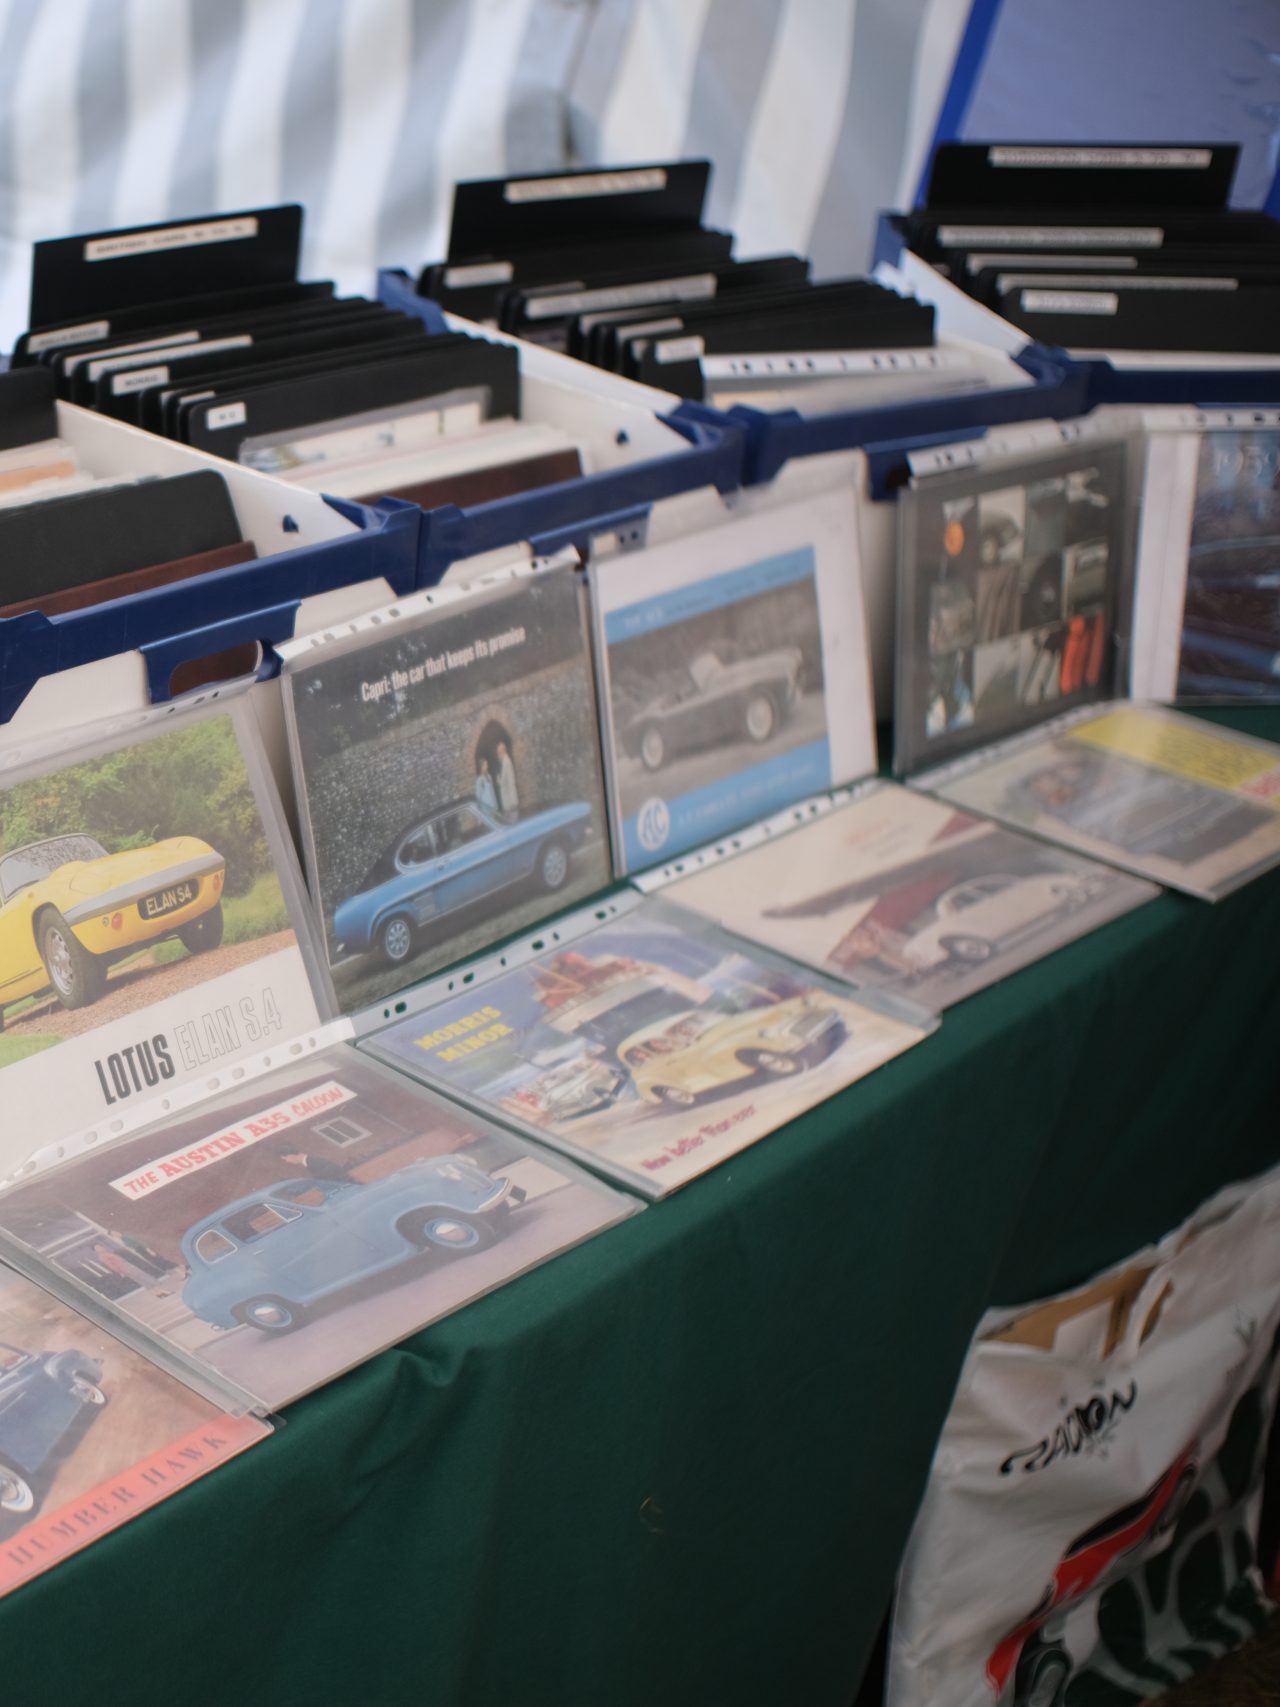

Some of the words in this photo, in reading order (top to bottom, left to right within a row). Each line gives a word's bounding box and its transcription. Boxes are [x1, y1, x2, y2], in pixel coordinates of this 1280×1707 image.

[361, 675, 392, 701] Capri:
[392, 668, 409, 690] the
[409, 667, 425, 684] car
[425, 654, 447, 677] that
[447, 646, 475, 670] keeps
[475, 639, 488, 658] its
[489, 626, 526, 656] promise
[146, 888, 177, 915] ELAN
[177, 883, 193, 903] S4
[94, 1034, 176, 1106] LOTUS
[173, 1005, 242, 1072] ELAN
[239, 987, 282, 1042] S.4
[414, 1006, 501, 1050] MORRIS
[436, 1023, 513, 1062] MINOR
[123, 1171, 160, 1194] THE
[158, 1131, 246, 1177] AUSTIN
[244, 1112, 292, 1139] A35
[7, 1486, 135, 1566] HUMBER
[140, 1432, 229, 1487] HAWK
